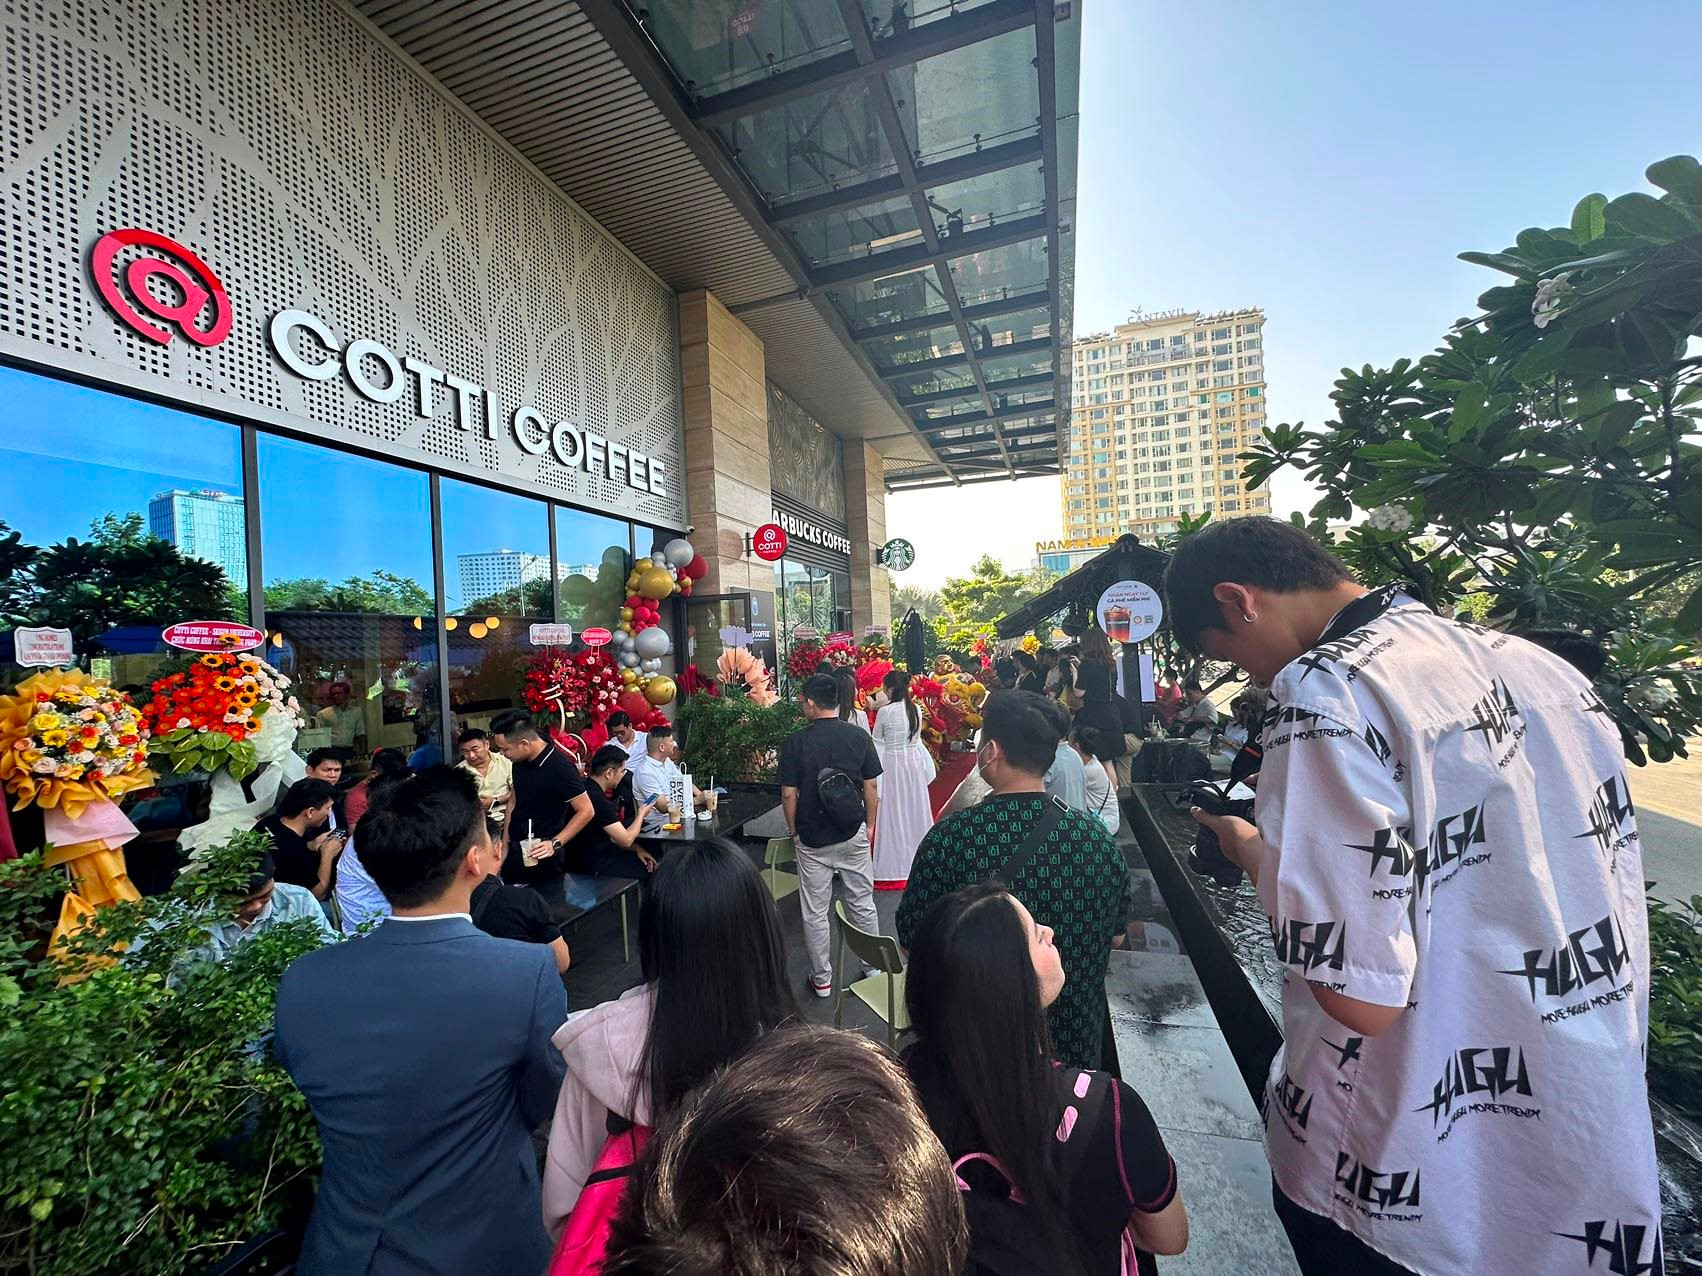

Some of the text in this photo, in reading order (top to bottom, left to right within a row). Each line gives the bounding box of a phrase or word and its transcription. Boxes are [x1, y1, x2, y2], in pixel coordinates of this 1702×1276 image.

[270, 308, 667, 498] COTTI COFFEE
[758, 542, 782, 550] COTTI
[822, 530, 851, 555] COFFEE
[1036, 540, 1071, 551] NAM
[190, 627, 209, 635] COFFEE
